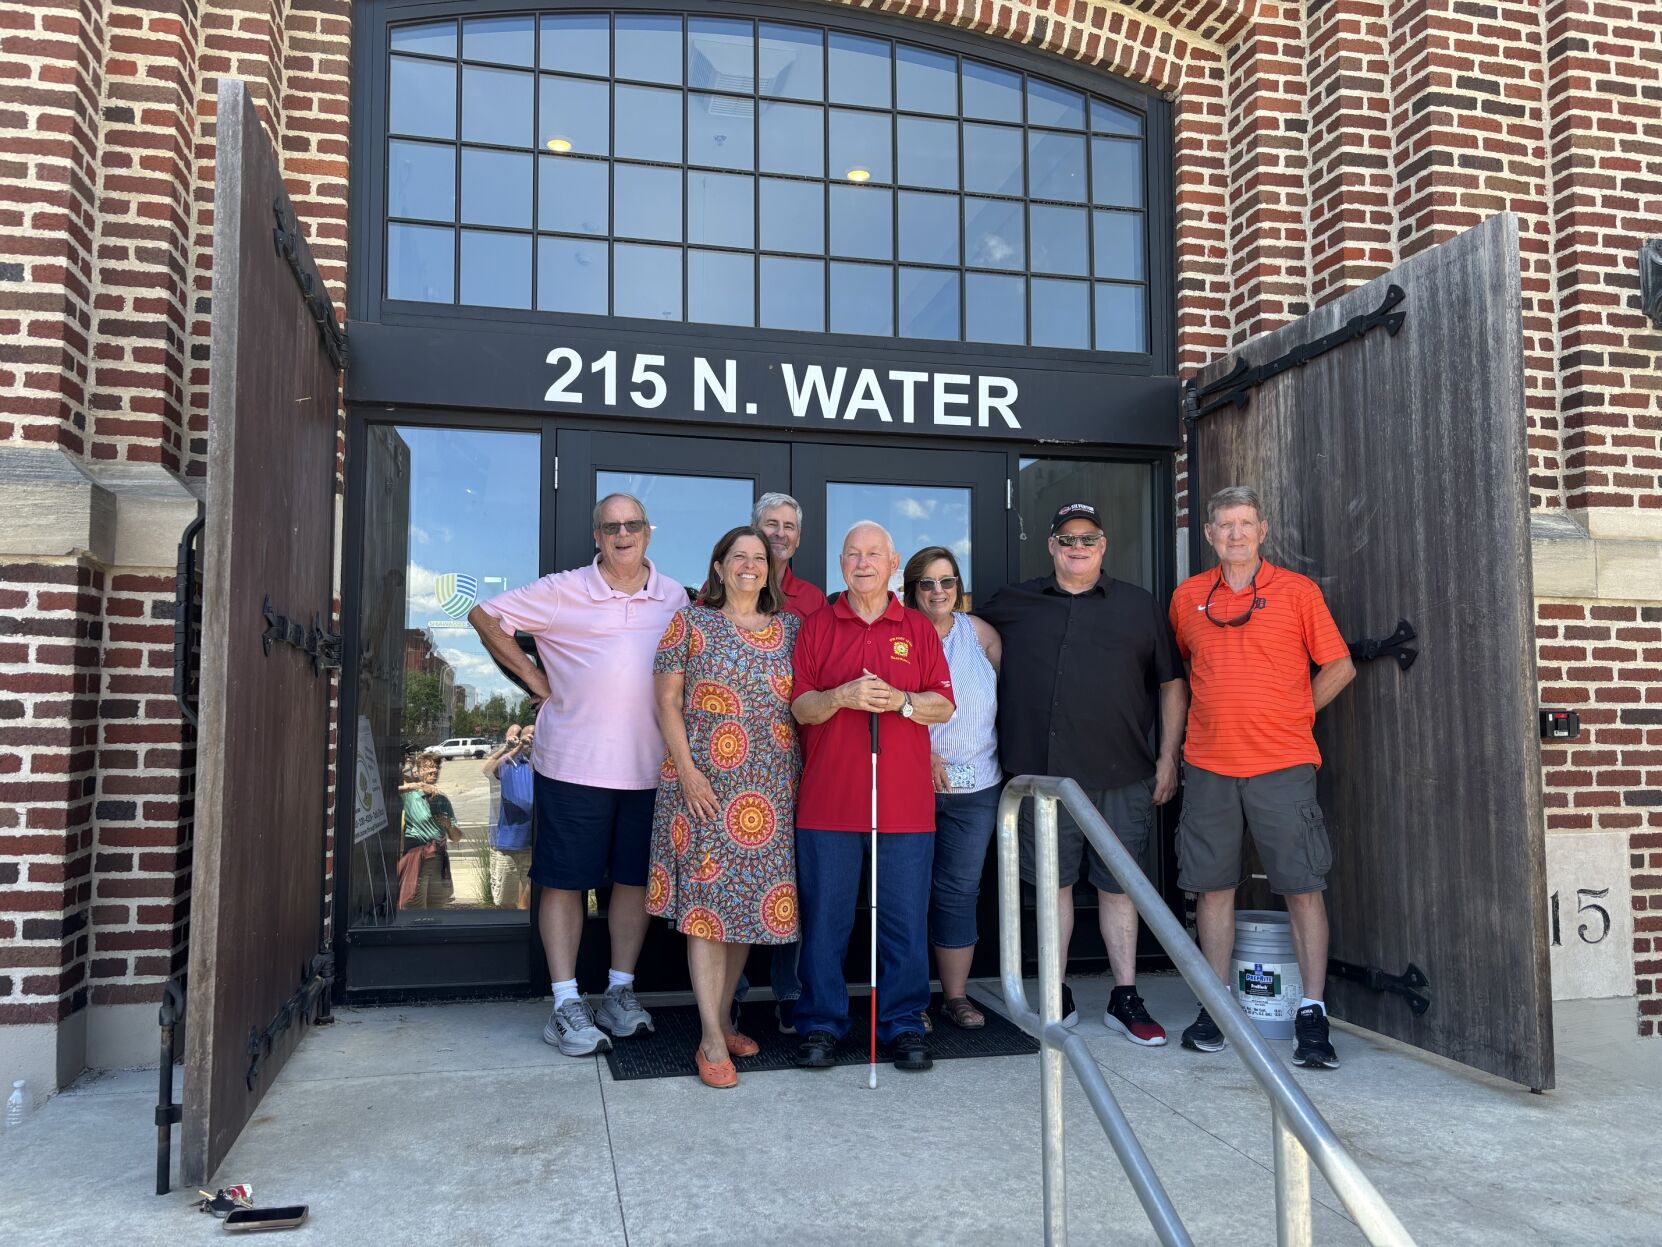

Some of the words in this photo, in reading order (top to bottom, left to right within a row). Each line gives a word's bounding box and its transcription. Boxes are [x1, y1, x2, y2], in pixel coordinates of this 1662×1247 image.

[544, 347, 667, 409] 215
[694, 357, 758, 415] N.
[781, 363, 1022, 429] WATER
